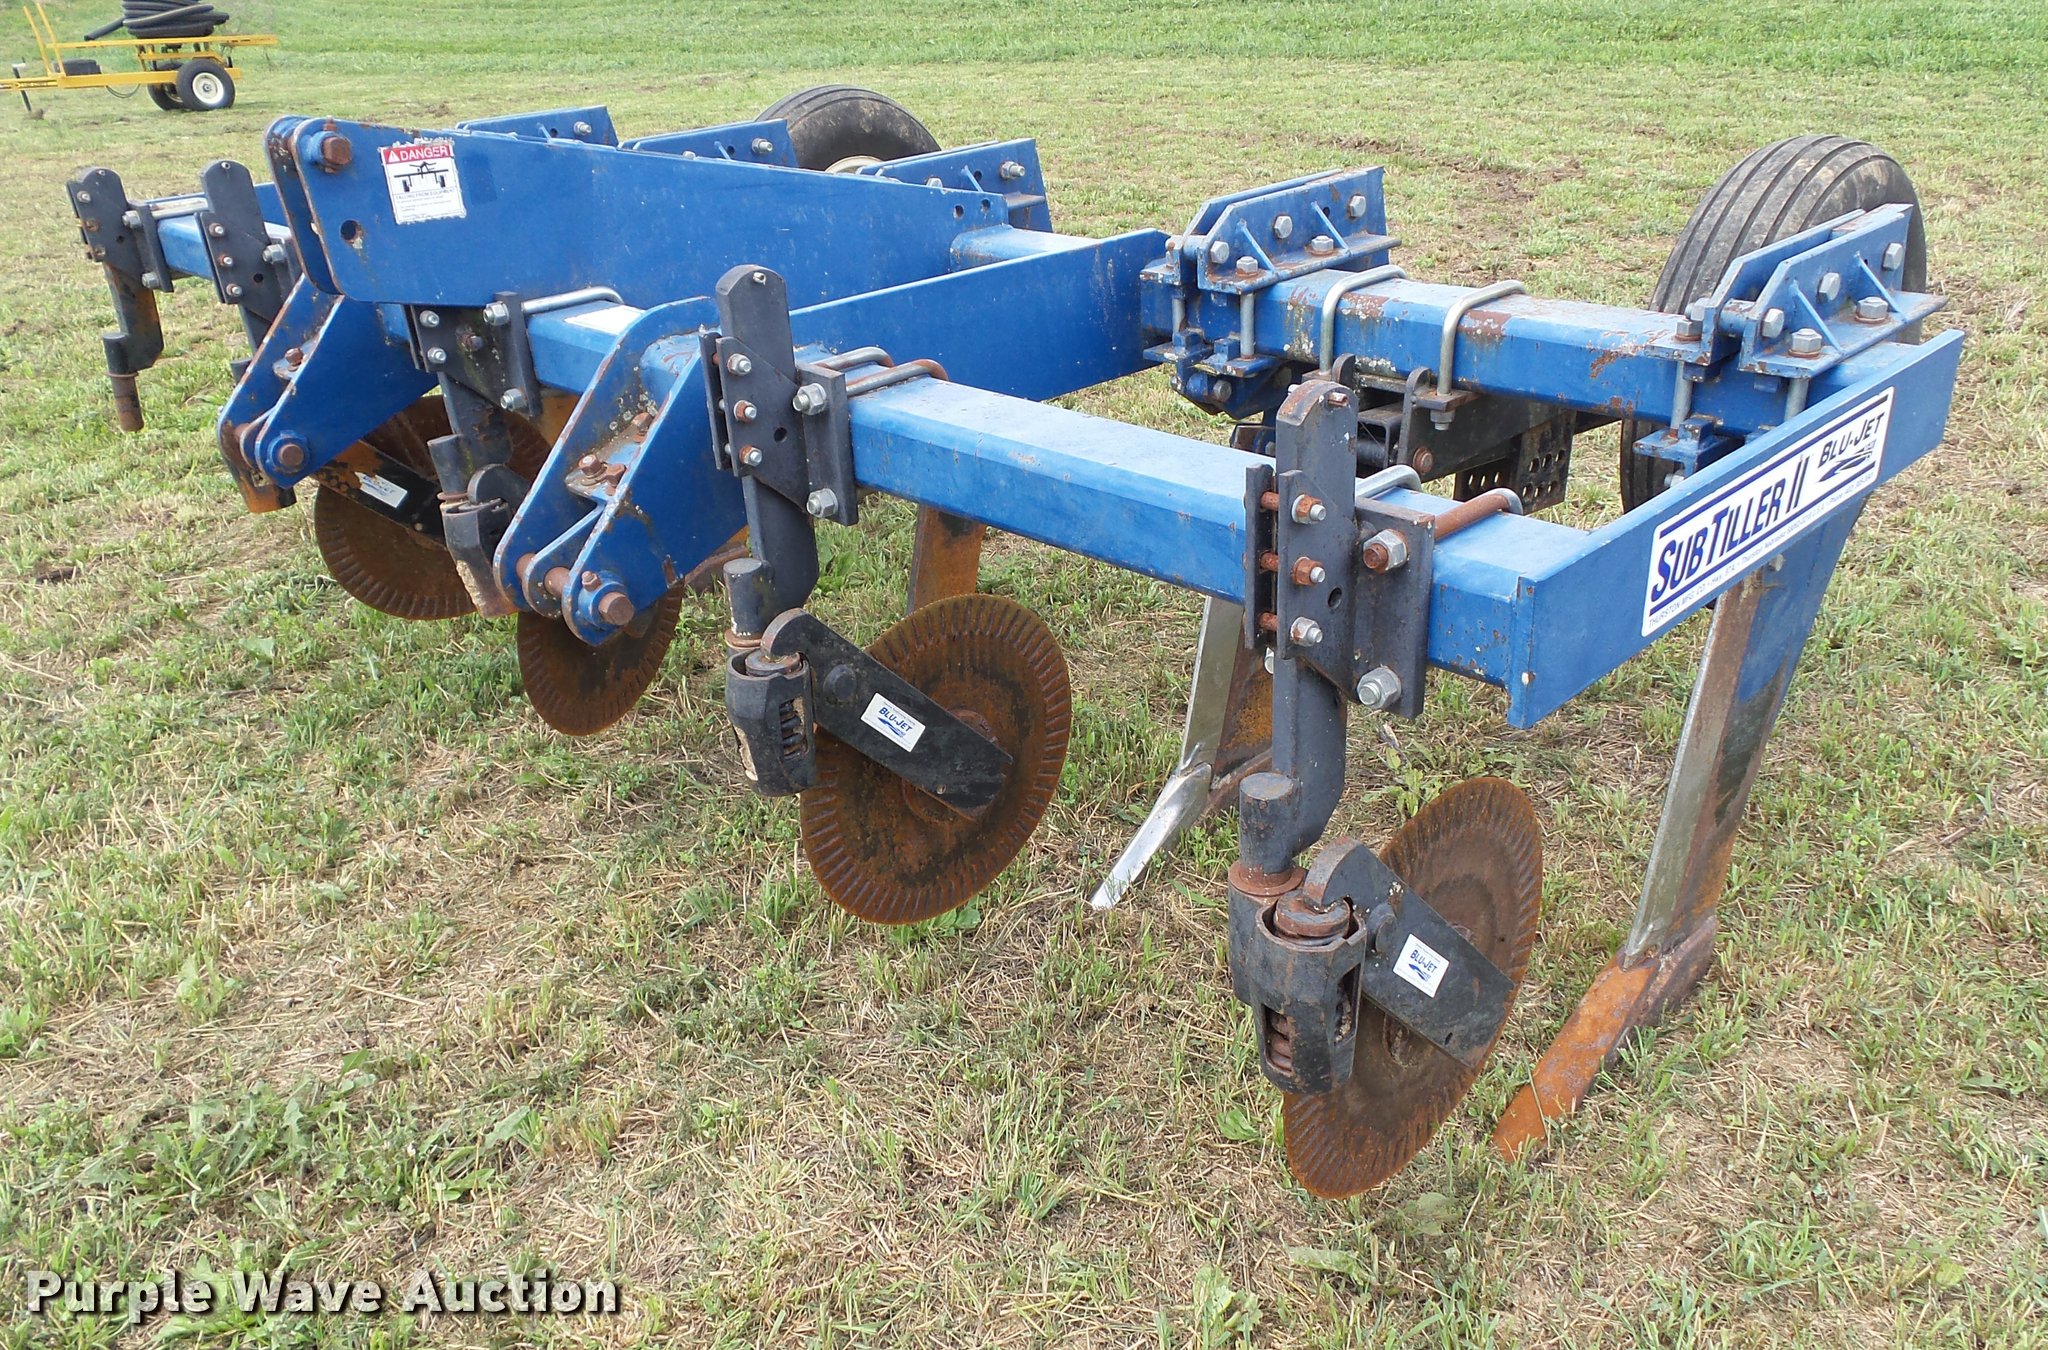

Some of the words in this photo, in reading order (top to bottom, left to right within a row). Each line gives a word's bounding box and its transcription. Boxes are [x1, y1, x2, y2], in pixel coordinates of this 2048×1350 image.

[401, 147, 448, 160] DANGER
[1818, 411, 1885, 468] BLU-JET
[1785, 455, 1810, 514] II
[878, 707, 913, 732] BLU-JET
[1410, 949, 1438, 973] BLU-JET
